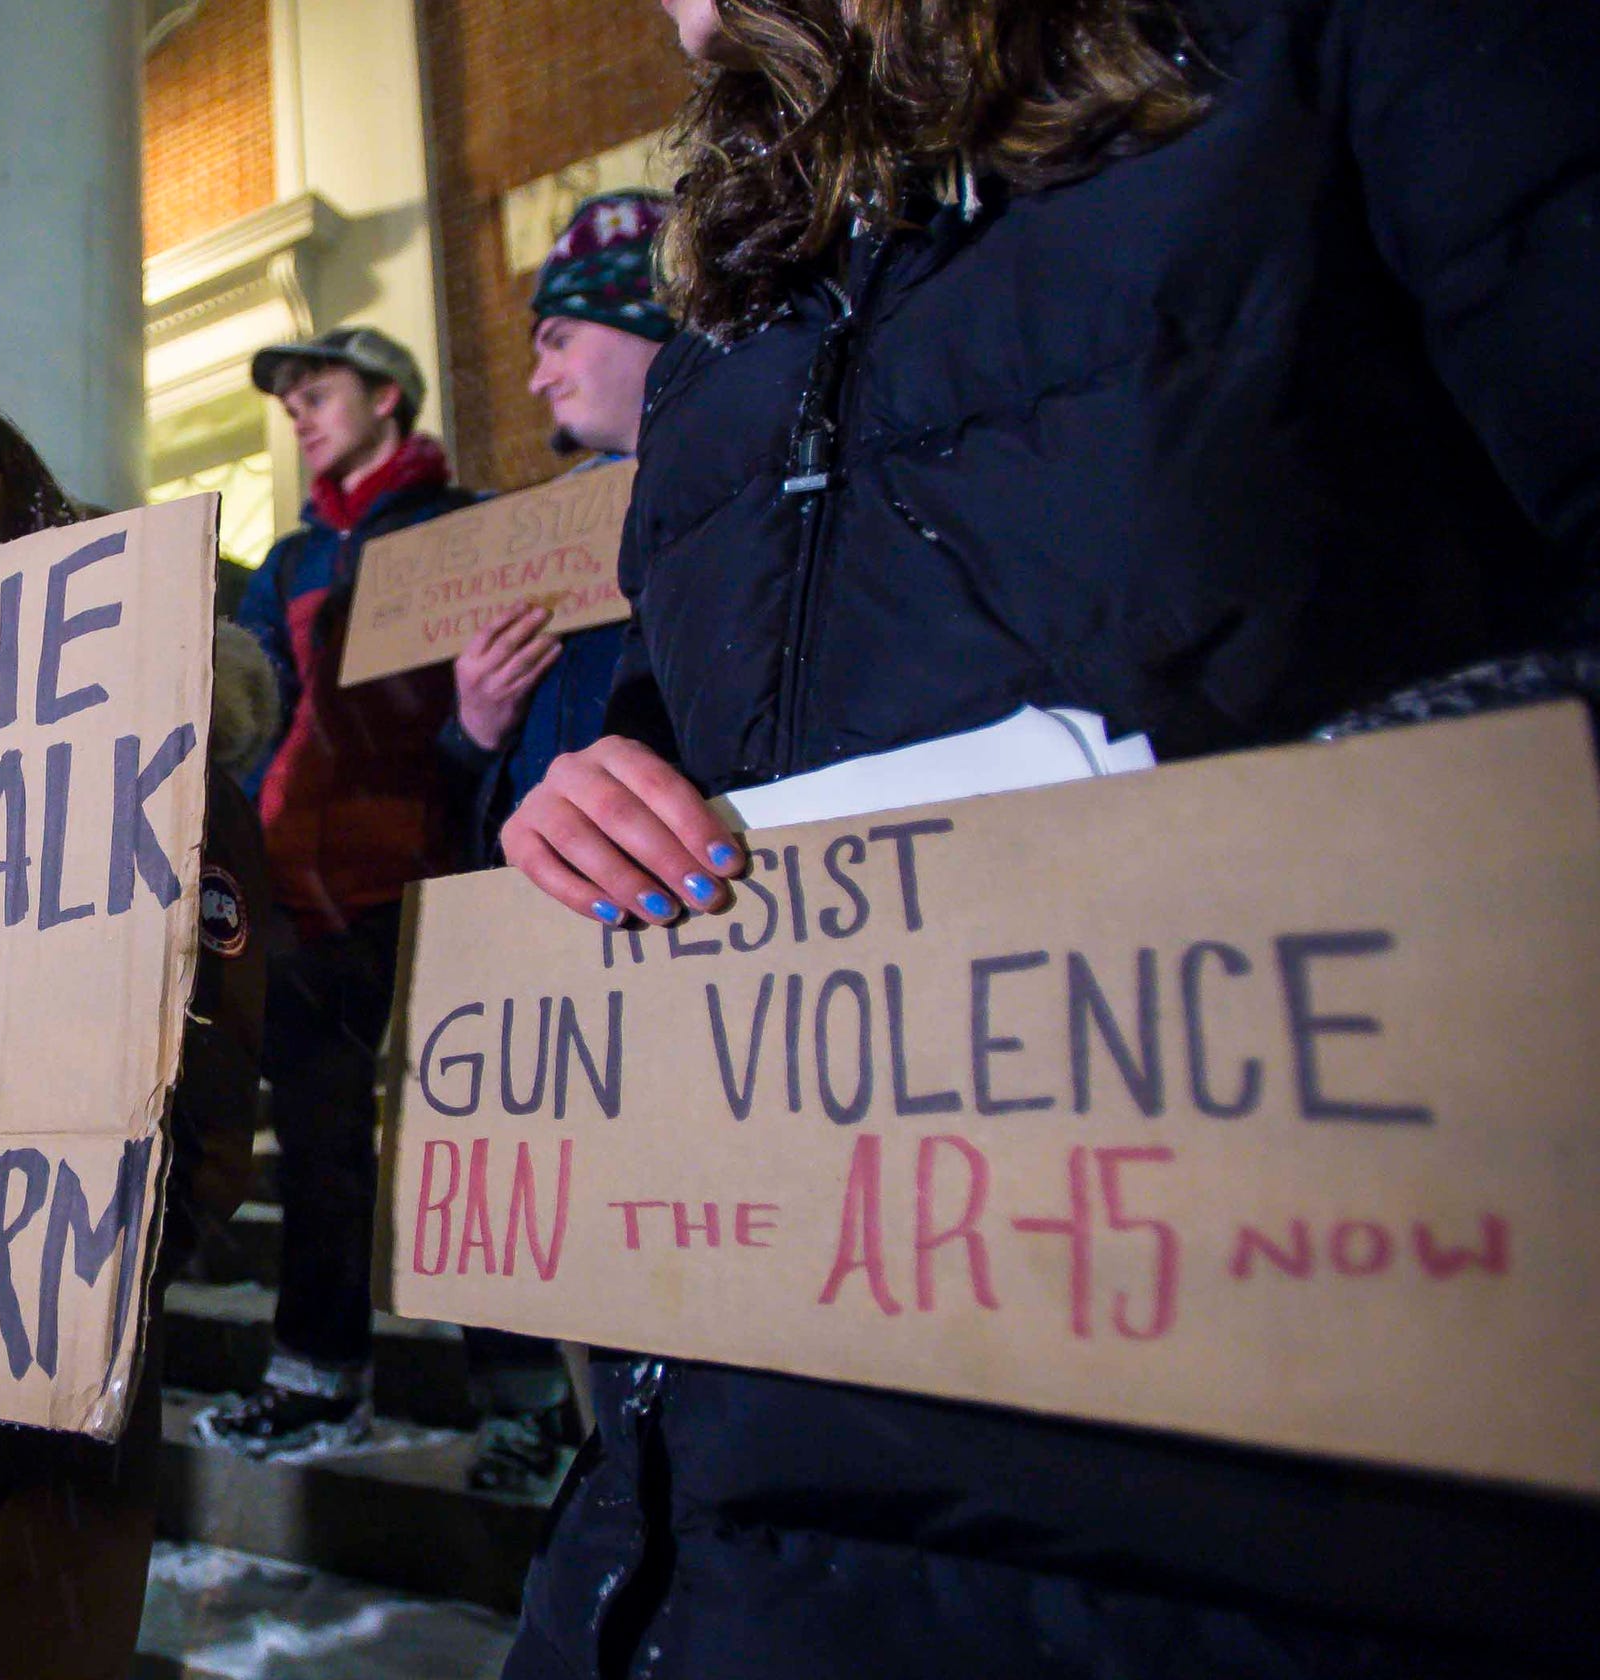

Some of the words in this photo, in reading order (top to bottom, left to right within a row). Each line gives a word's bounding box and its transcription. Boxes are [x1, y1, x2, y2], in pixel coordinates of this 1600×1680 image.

[419, 991, 624, 1120] GUN
[705, 929, 1437, 1127] VIOLENCE
[413, 1137, 573, 1281] BAN
[607, 1200, 780, 1251] THE
[817, 1133, 1181, 1341] AR-15
[1228, 1212, 1510, 1281] NOW
